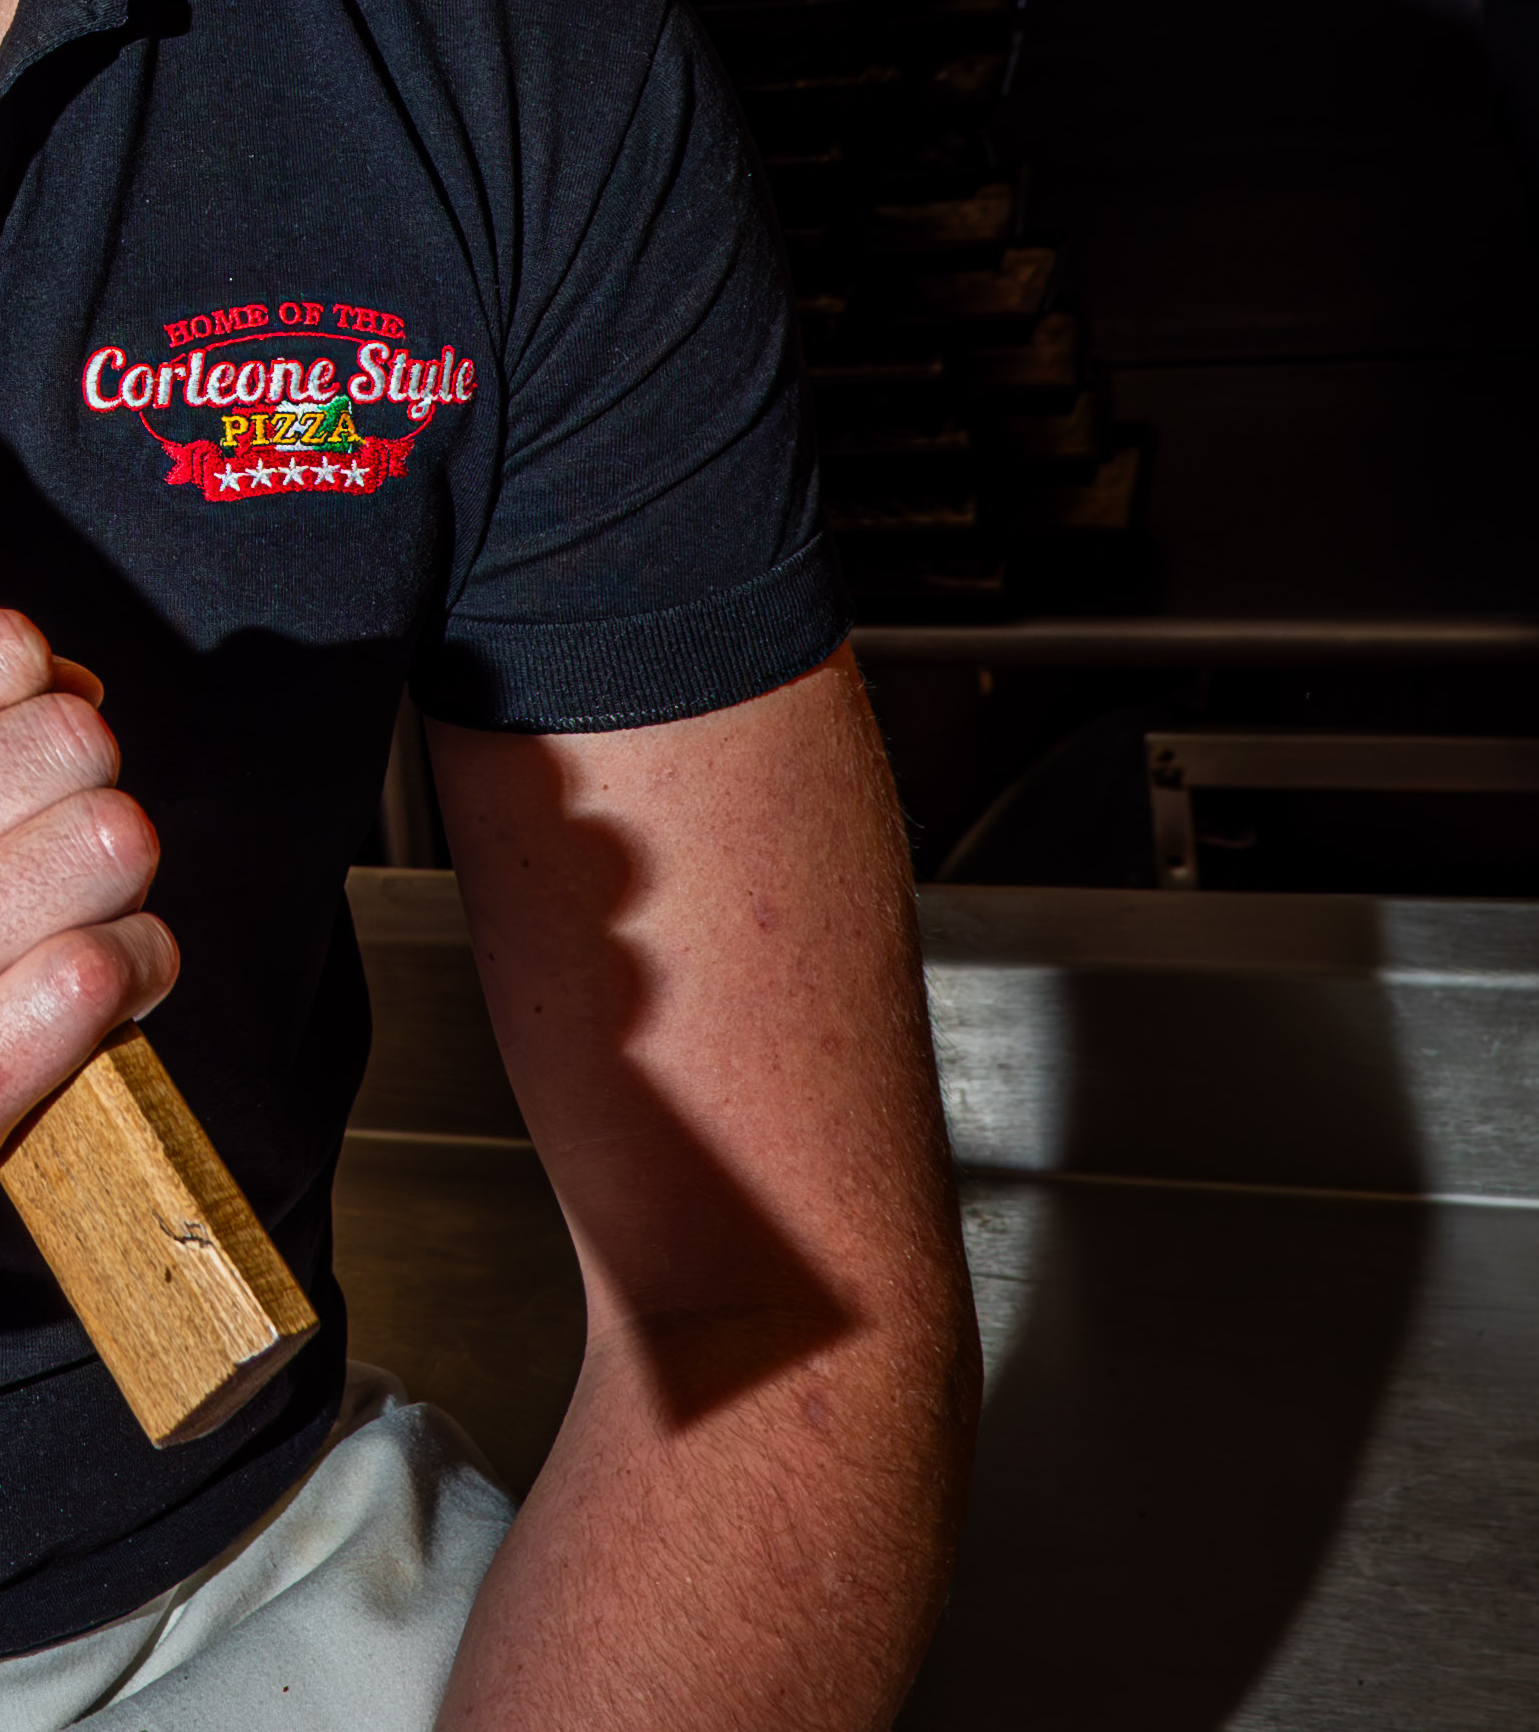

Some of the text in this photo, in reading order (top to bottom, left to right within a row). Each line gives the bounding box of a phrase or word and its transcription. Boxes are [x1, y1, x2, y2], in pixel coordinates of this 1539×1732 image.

[164, 301, 407, 348] HOME OF THE
[83, 341, 478, 421] Corleone Style
[221, 409, 360, 448] PIZZA
